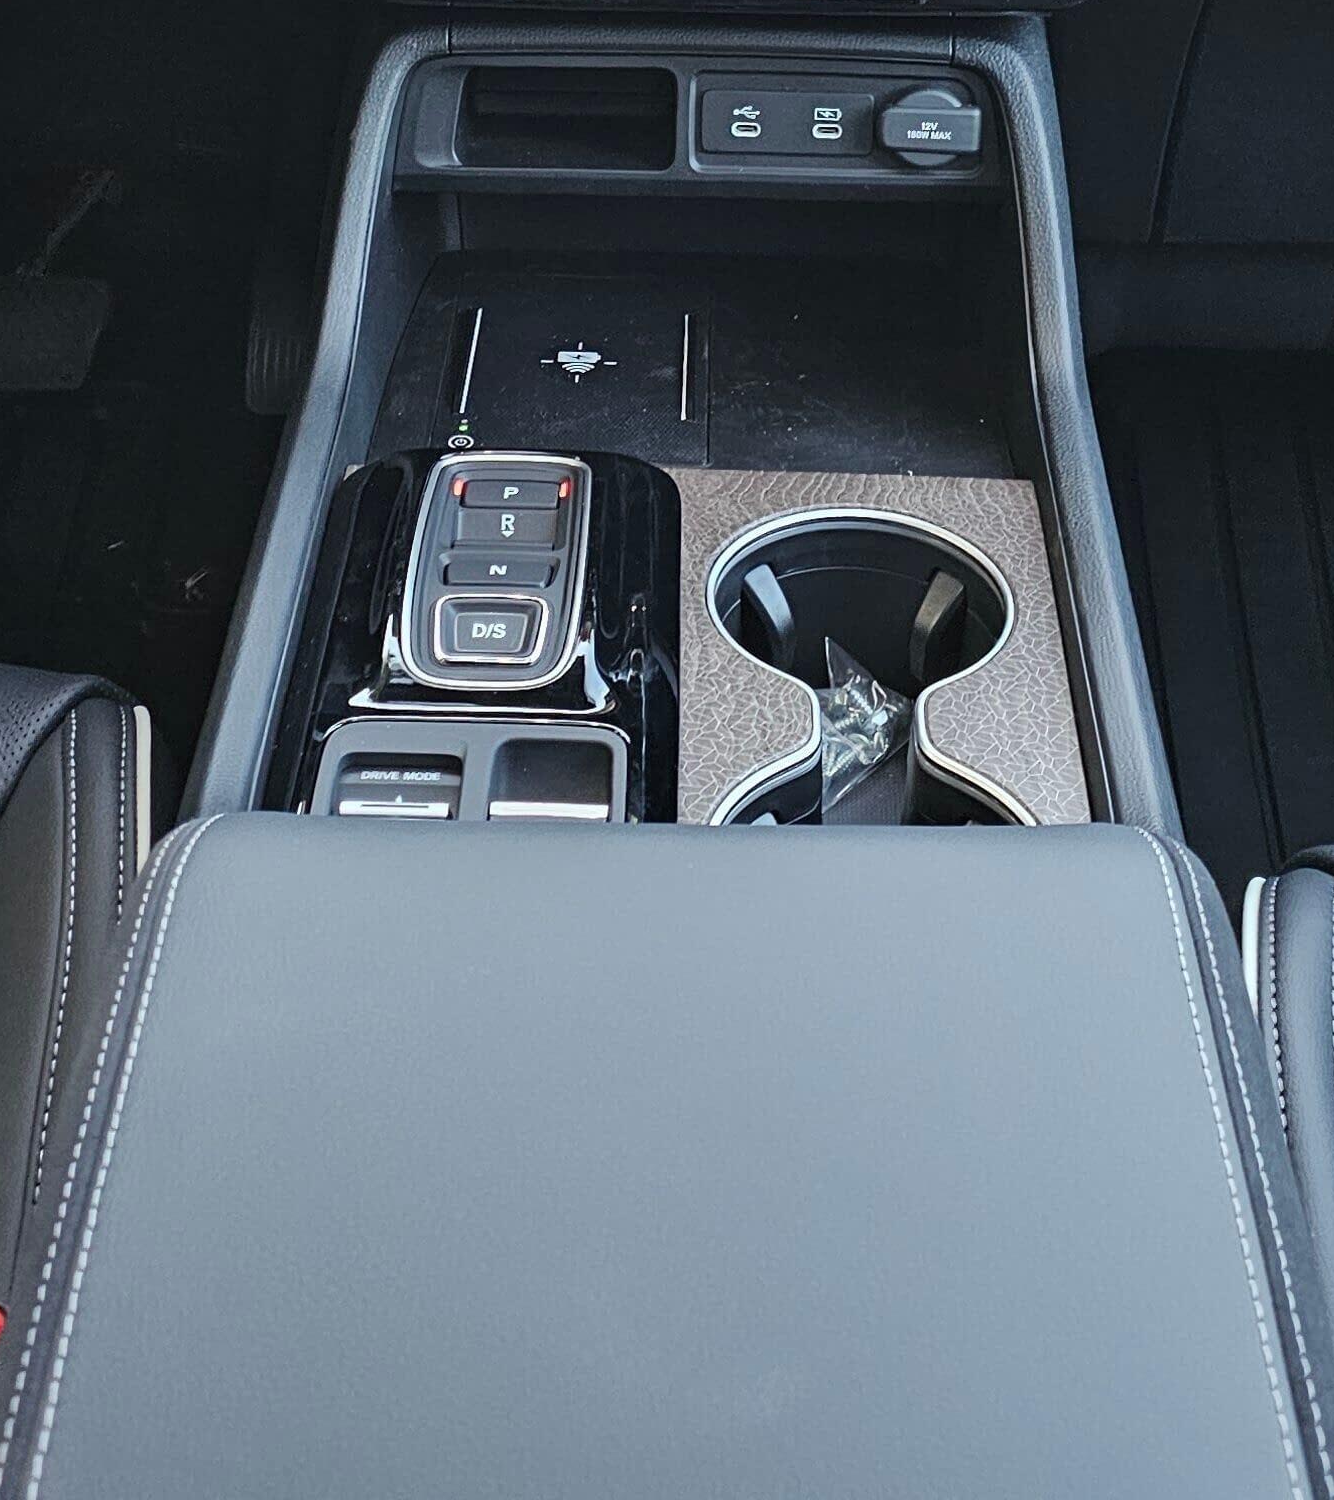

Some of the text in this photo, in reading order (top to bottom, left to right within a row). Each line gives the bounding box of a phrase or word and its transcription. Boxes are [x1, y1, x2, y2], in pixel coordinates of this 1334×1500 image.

[921, 121, 939, 131] 12V
[930, 131, 952, 140] MAX
[503, 486, 520, 499] P
[501, 513, 516, 532] R
[489, 565, 508, 576] N
[471, 623, 507, 639] D/S
[359, 770, 441, 781] DRIVE MODE
